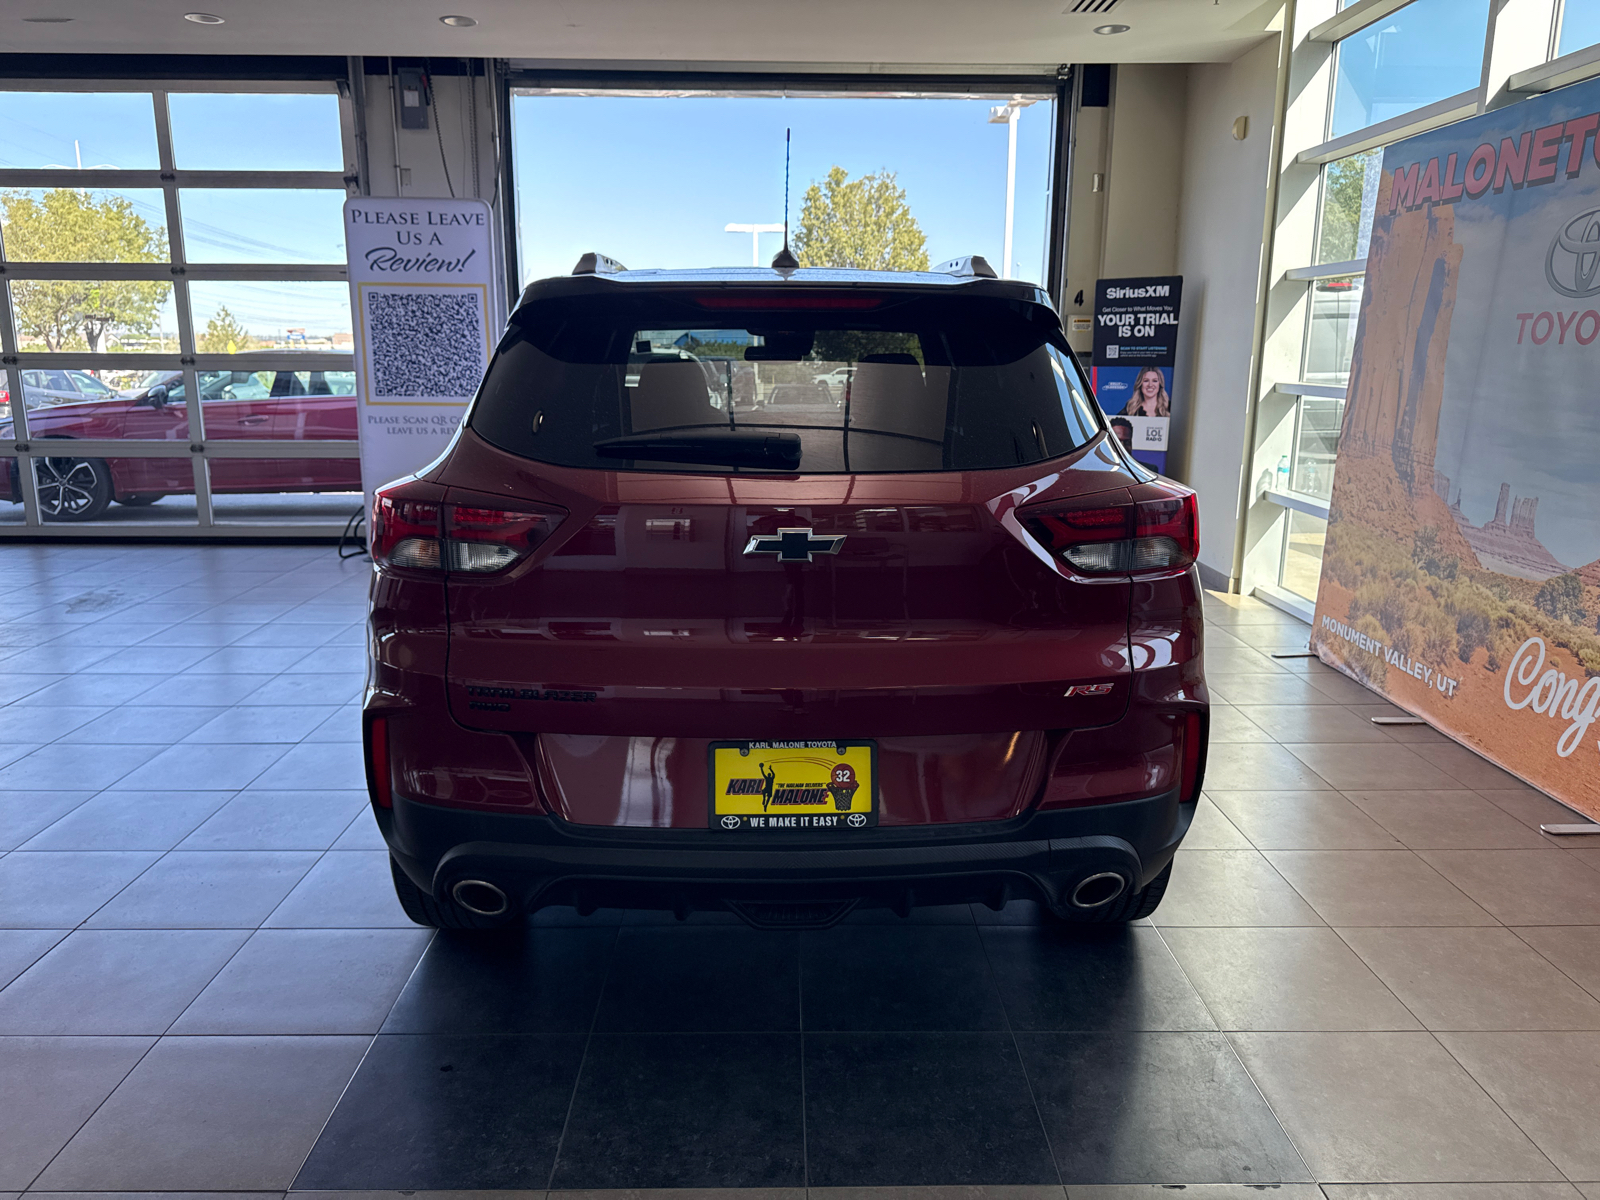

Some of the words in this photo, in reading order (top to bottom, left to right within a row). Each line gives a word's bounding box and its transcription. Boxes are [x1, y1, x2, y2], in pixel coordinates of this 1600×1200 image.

[1388, 112, 1600, 216] MALONET
[351, 209, 419, 225] PLEASE
[428, 211, 485, 226] LEAVE
[396, 231, 422, 245] US
[429, 231, 443, 246] A
[365, 247, 476, 273] Review!
[1074, 289, 1084, 307] 4
[1106, 285, 1170, 299] SiriusXM
[1097, 314, 1135, 326] YOUR
[1137, 313, 1178, 325] TRIAL
[1118, 326, 1131, 337] IS
[1134, 325, 1155, 337] ON
[368, 415, 400, 425] PLEASE
[403, 415, 428, 424] SCAN
[431, 415, 448, 426] QR
[387, 427, 414, 435] LEAVE
[416, 427, 428, 435] US
[431, 427, 438, 435] A
[1146, 429, 1162, 437] LOL
[1321, 614, 1382, 657] MONUMENT
[1384, 646, 1433, 689] VALLEY,
[1436, 674, 1457, 697] UT
[1063, 683, 1115, 697] RS
[1504, 637, 1600, 758] Cong
[469, 701, 511, 712] AWD
[772, 741, 805, 749] MALONE
[835, 770, 850, 782] 32
[725, 778, 764, 795] KARL
[771, 788, 829, 805] MALONE
[750, 817, 765, 828] WE
[769, 817, 797, 828] MAKE
[800, 817, 810, 827] IT
[813, 816, 838, 826] EASY
